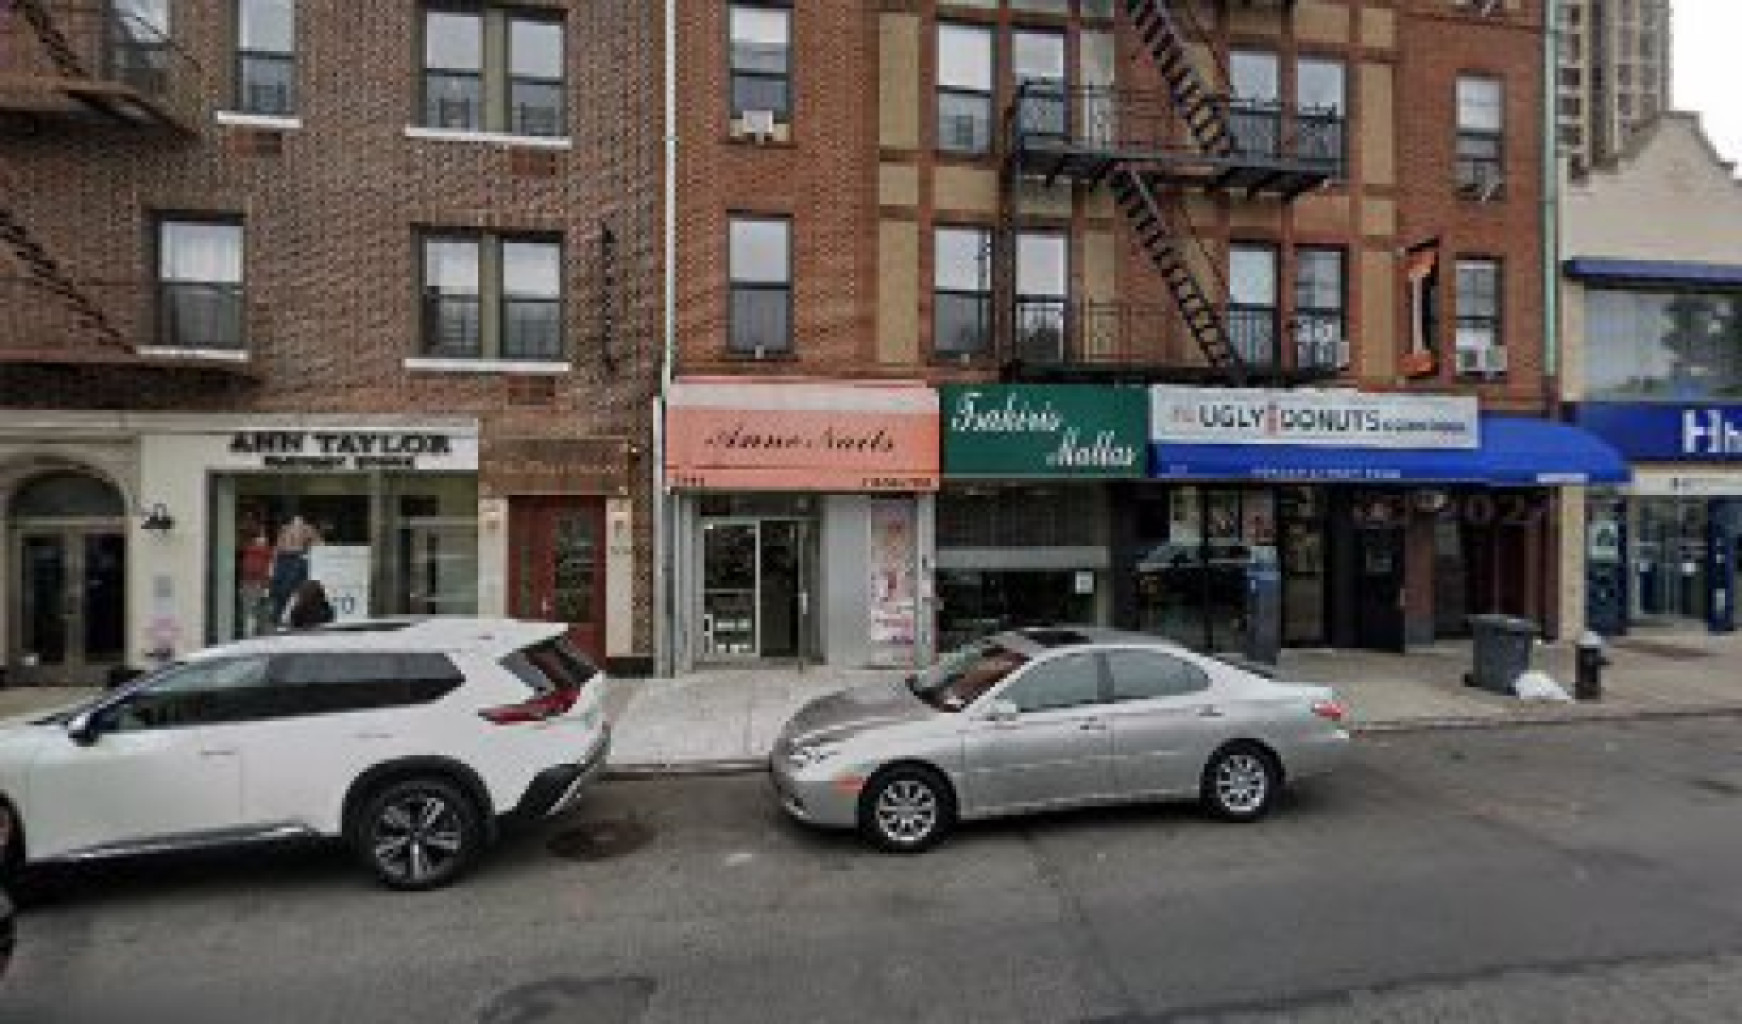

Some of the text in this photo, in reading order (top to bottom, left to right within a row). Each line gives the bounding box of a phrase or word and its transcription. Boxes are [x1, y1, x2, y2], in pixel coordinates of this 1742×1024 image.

[1200, 403, 1265, 429] UGLY
[1280, 409, 1380, 433] DONUTS
[229, 431, 451, 455] ANN TAYLOR
